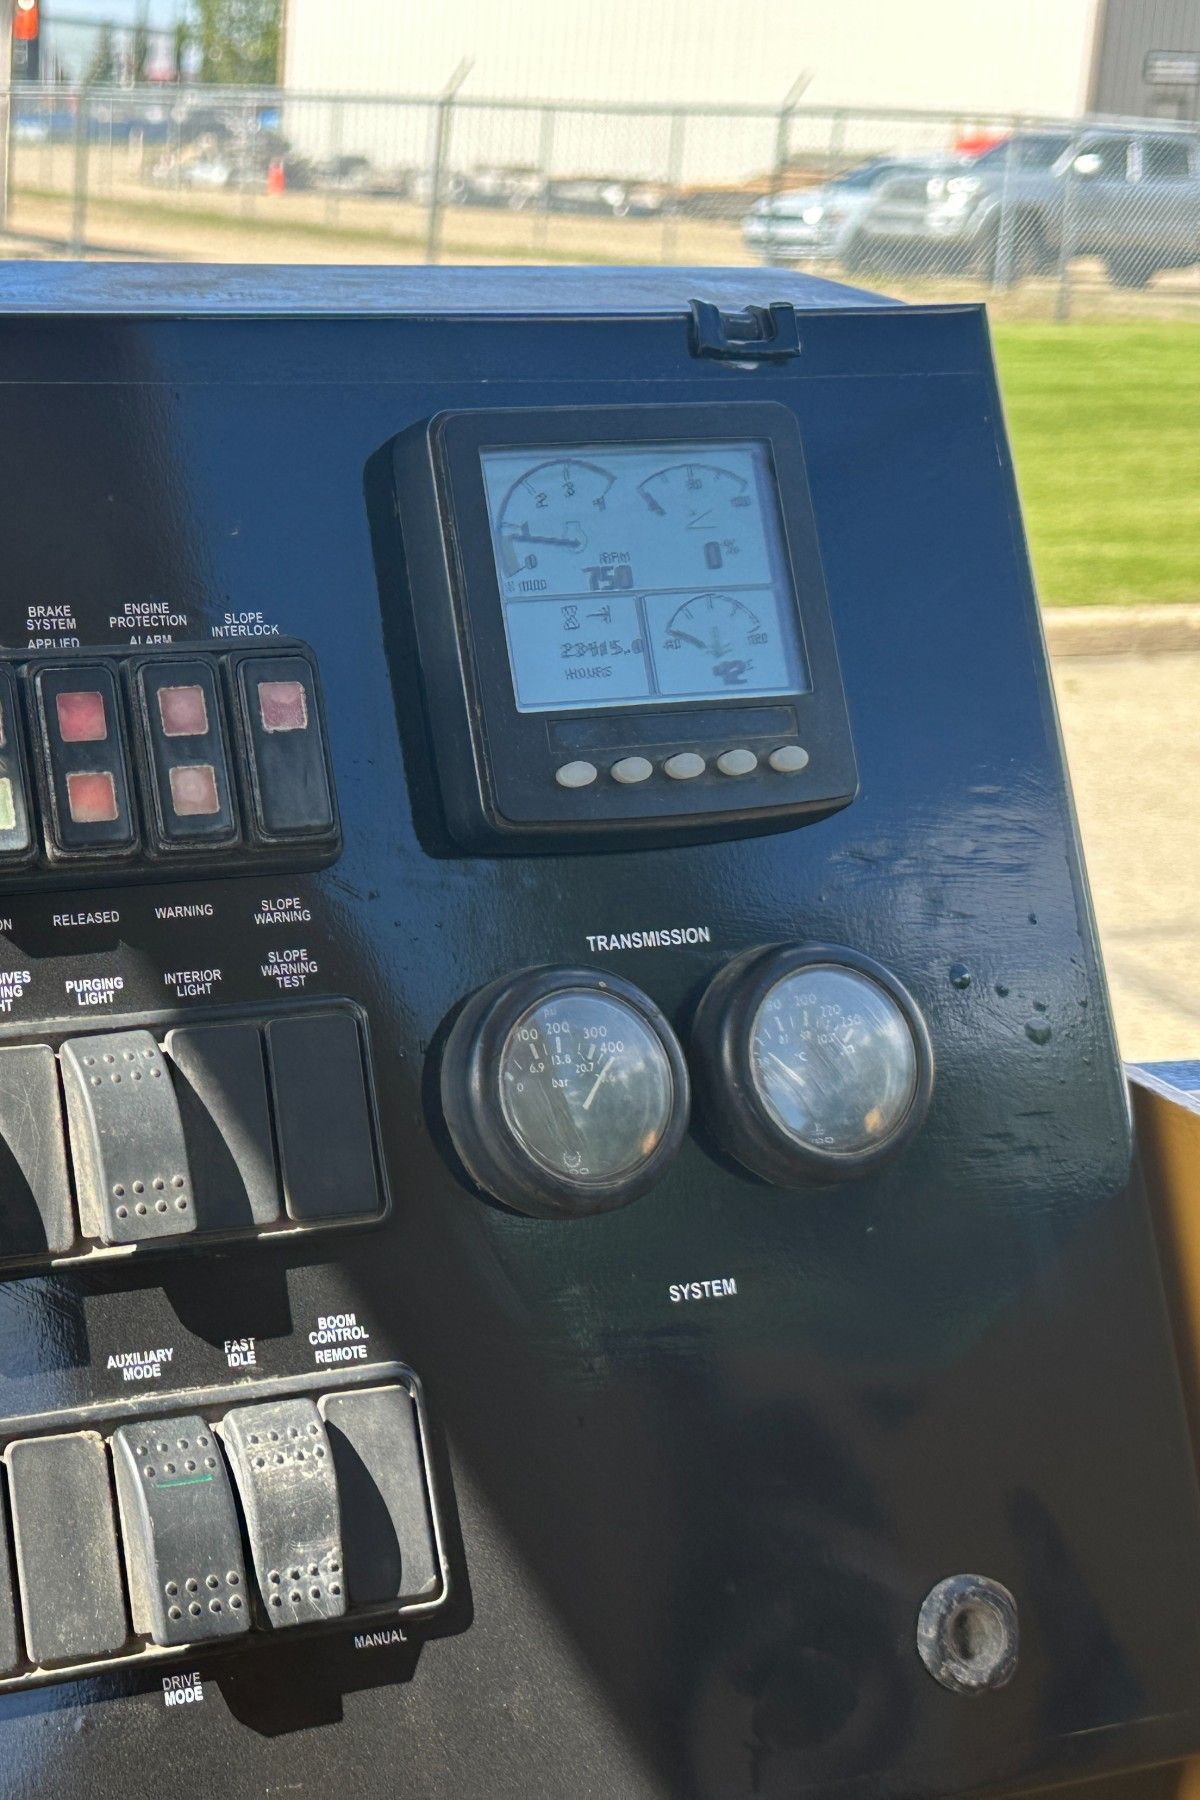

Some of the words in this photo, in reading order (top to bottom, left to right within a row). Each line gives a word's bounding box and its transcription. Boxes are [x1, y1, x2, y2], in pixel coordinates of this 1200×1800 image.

[581, 565, 633, 591] 750
[28, 605, 72, 618] BRAKE
[124, 602, 170, 615] ENGINE
[26, 617, 77, 631] SYSTEM
[109, 614, 188, 628] PROTECTION
[224, 612, 263, 625] SLOPE
[211, 624, 280, 638] INTERLOCK
[27, 637, 80, 650] APPLIED
[129, 634, 172, 645] ALARM
[154, 904, 214, 919] WARNING
[261, 897, 301, 912] SLOPE
[52, 910, 120, 927] RELEASED
[254, 909, 312, 925] WARNING
[586, 926, 711, 952] TRANSMISSION
[268, 949, 308, 963] SLOPE
[260, 961, 318, 977] WARNING
[65, 976, 124, 993] PURGING
[164, 969, 222, 985] INTERIOR
[276, 974, 306, 989] TEST
[176, 982, 212, 997] LIGHT
[77, 990, 114, 1006] LIGHT
[517, 1029, 538, 1041] 100
[546, 1021, 570, 1035] 200
[583, 1025, 607, 1039] 300
[600, 1040, 624, 1054] 400
[529, 1062, 545, 1074] 6.9
[517, 1083, 524, 1092] 0
[551, 1078, 568, 1088] bar
[669, 1278, 738, 1302] SYSTEM
[317, 1313, 357, 1331] BOOM
[308, 1325, 370, 1345] CONTROL
[224, 1337, 256, 1353] FAST
[106, 1348, 174, 1369] AUXILIARY
[227, 1351, 257, 1368] IDLE
[315, 1345, 368, 1364] REMOTE
[123, 1363, 162, 1381] MODE
[354, 1630, 407, 1650] MANUAL
[162, 1671, 201, 1691] DRIVE
[164, 1686, 203, 1707] MODE
